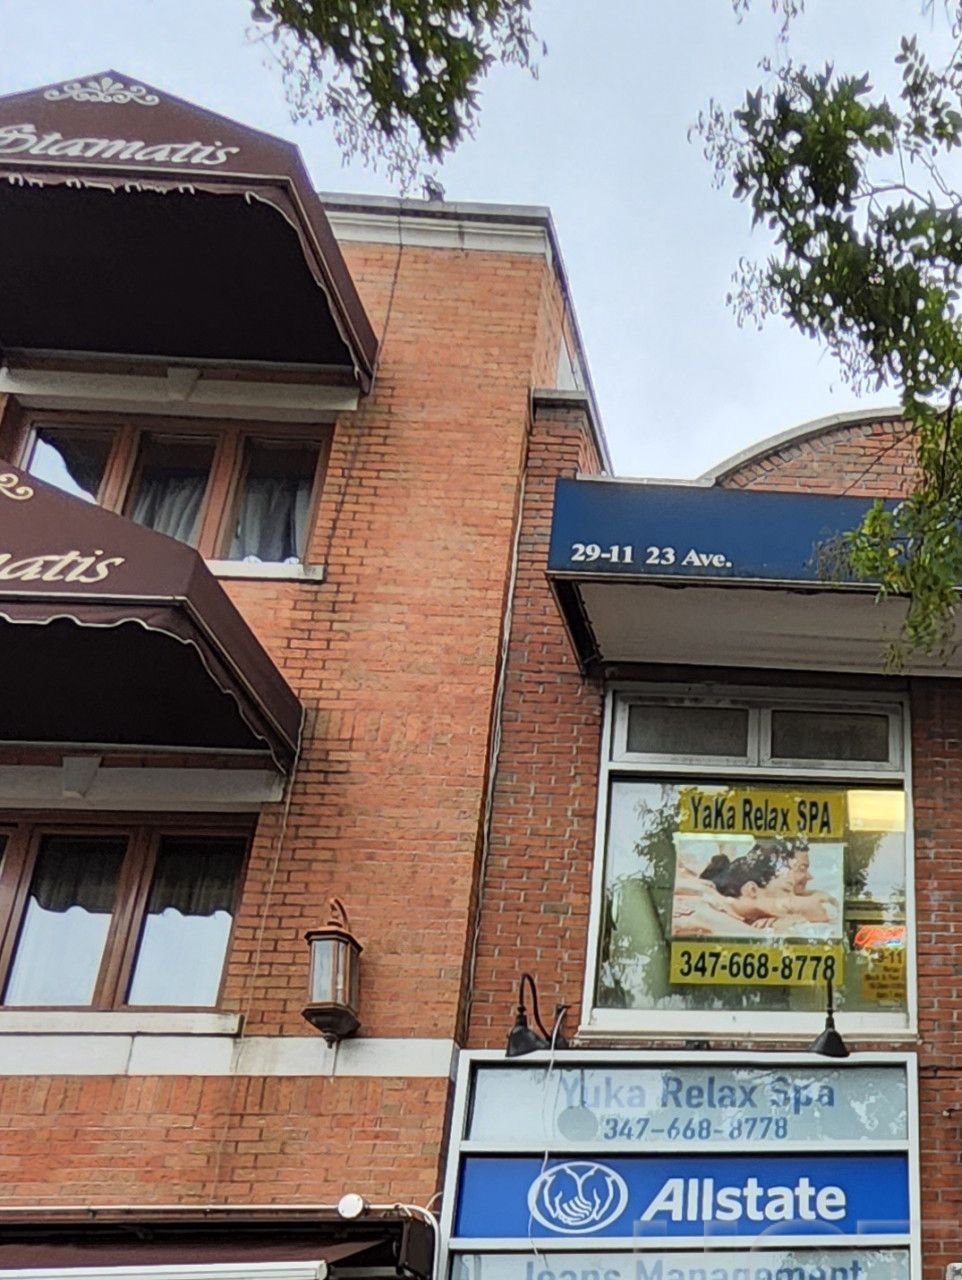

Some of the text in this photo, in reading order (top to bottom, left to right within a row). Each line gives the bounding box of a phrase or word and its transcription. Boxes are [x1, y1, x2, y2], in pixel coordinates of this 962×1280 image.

[571, 543, 733, 569] 29-11 23 Ave.
[742, 798, 790, 832] Relax
[797, 800, 832, 834] SPA
[679, 949, 836, 982] 347-668-8778
[661, 1076, 758, 1108] Relax
[769, 1075, 836, 1114] Spa
[603, 1116, 788, 1140] 347-668-8778
[640, 1176, 847, 1222] Allstate
